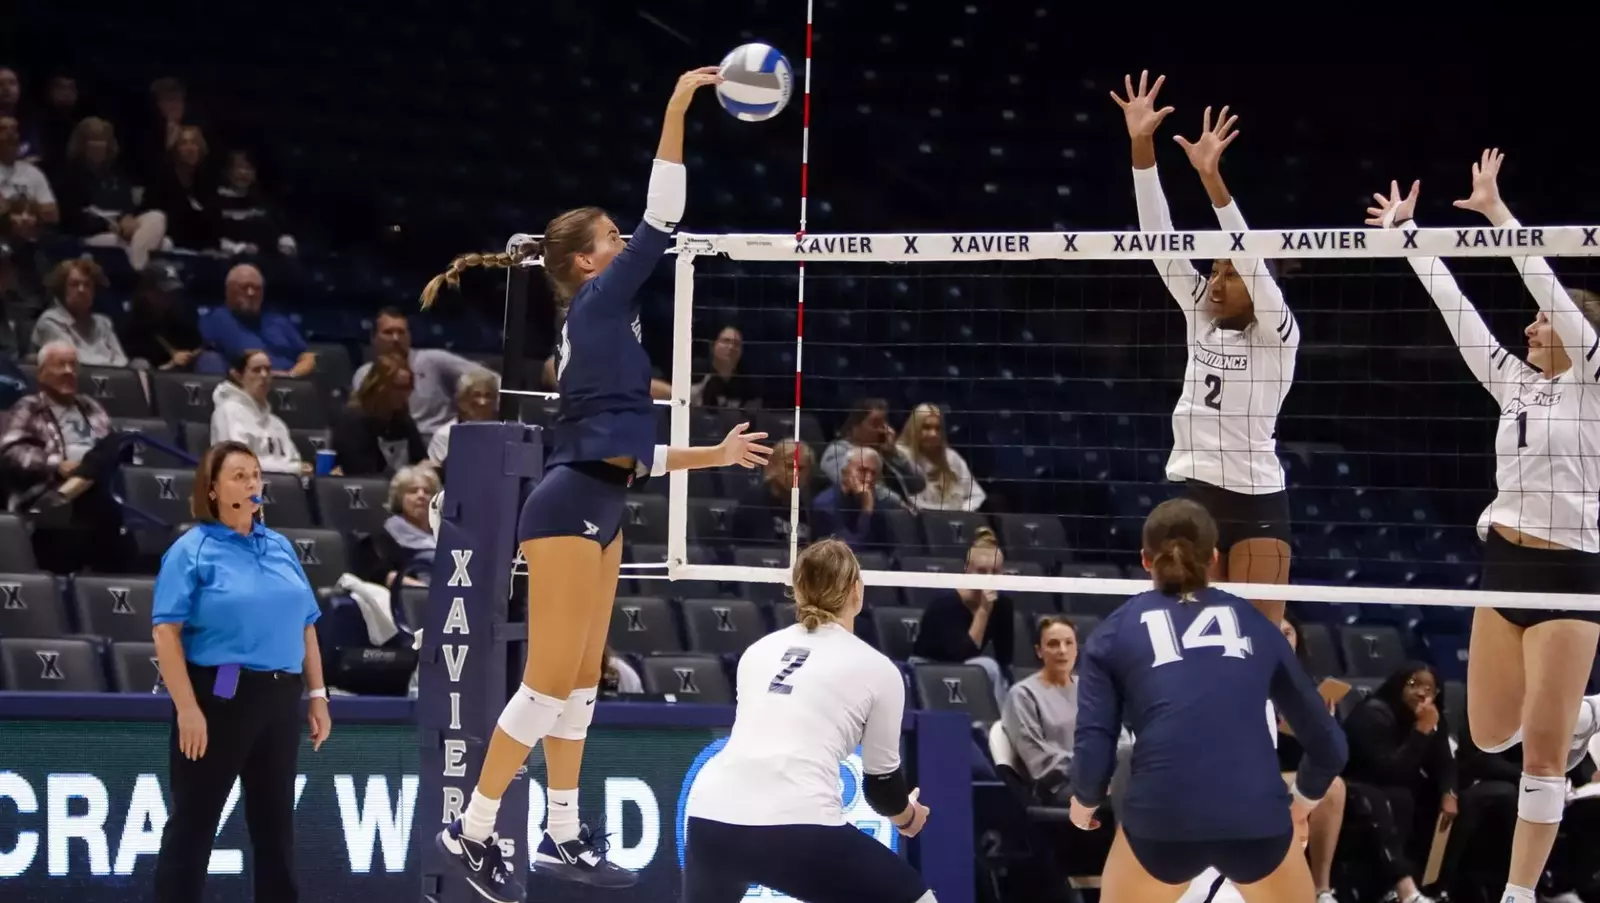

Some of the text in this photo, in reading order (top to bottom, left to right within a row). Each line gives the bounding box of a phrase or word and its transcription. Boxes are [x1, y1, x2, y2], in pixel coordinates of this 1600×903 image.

[795, 227, 1598, 254] XAVIER X XAVIER X XAVIER X XAVIER X XAVIER X
[1204, 373, 1222, 410] 2
[1515, 411, 1528, 448] 1
[1140, 605, 1254, 668] 14
[442, 549, 473, 823] XAVIER
[768, 647, 811, 695] 2
